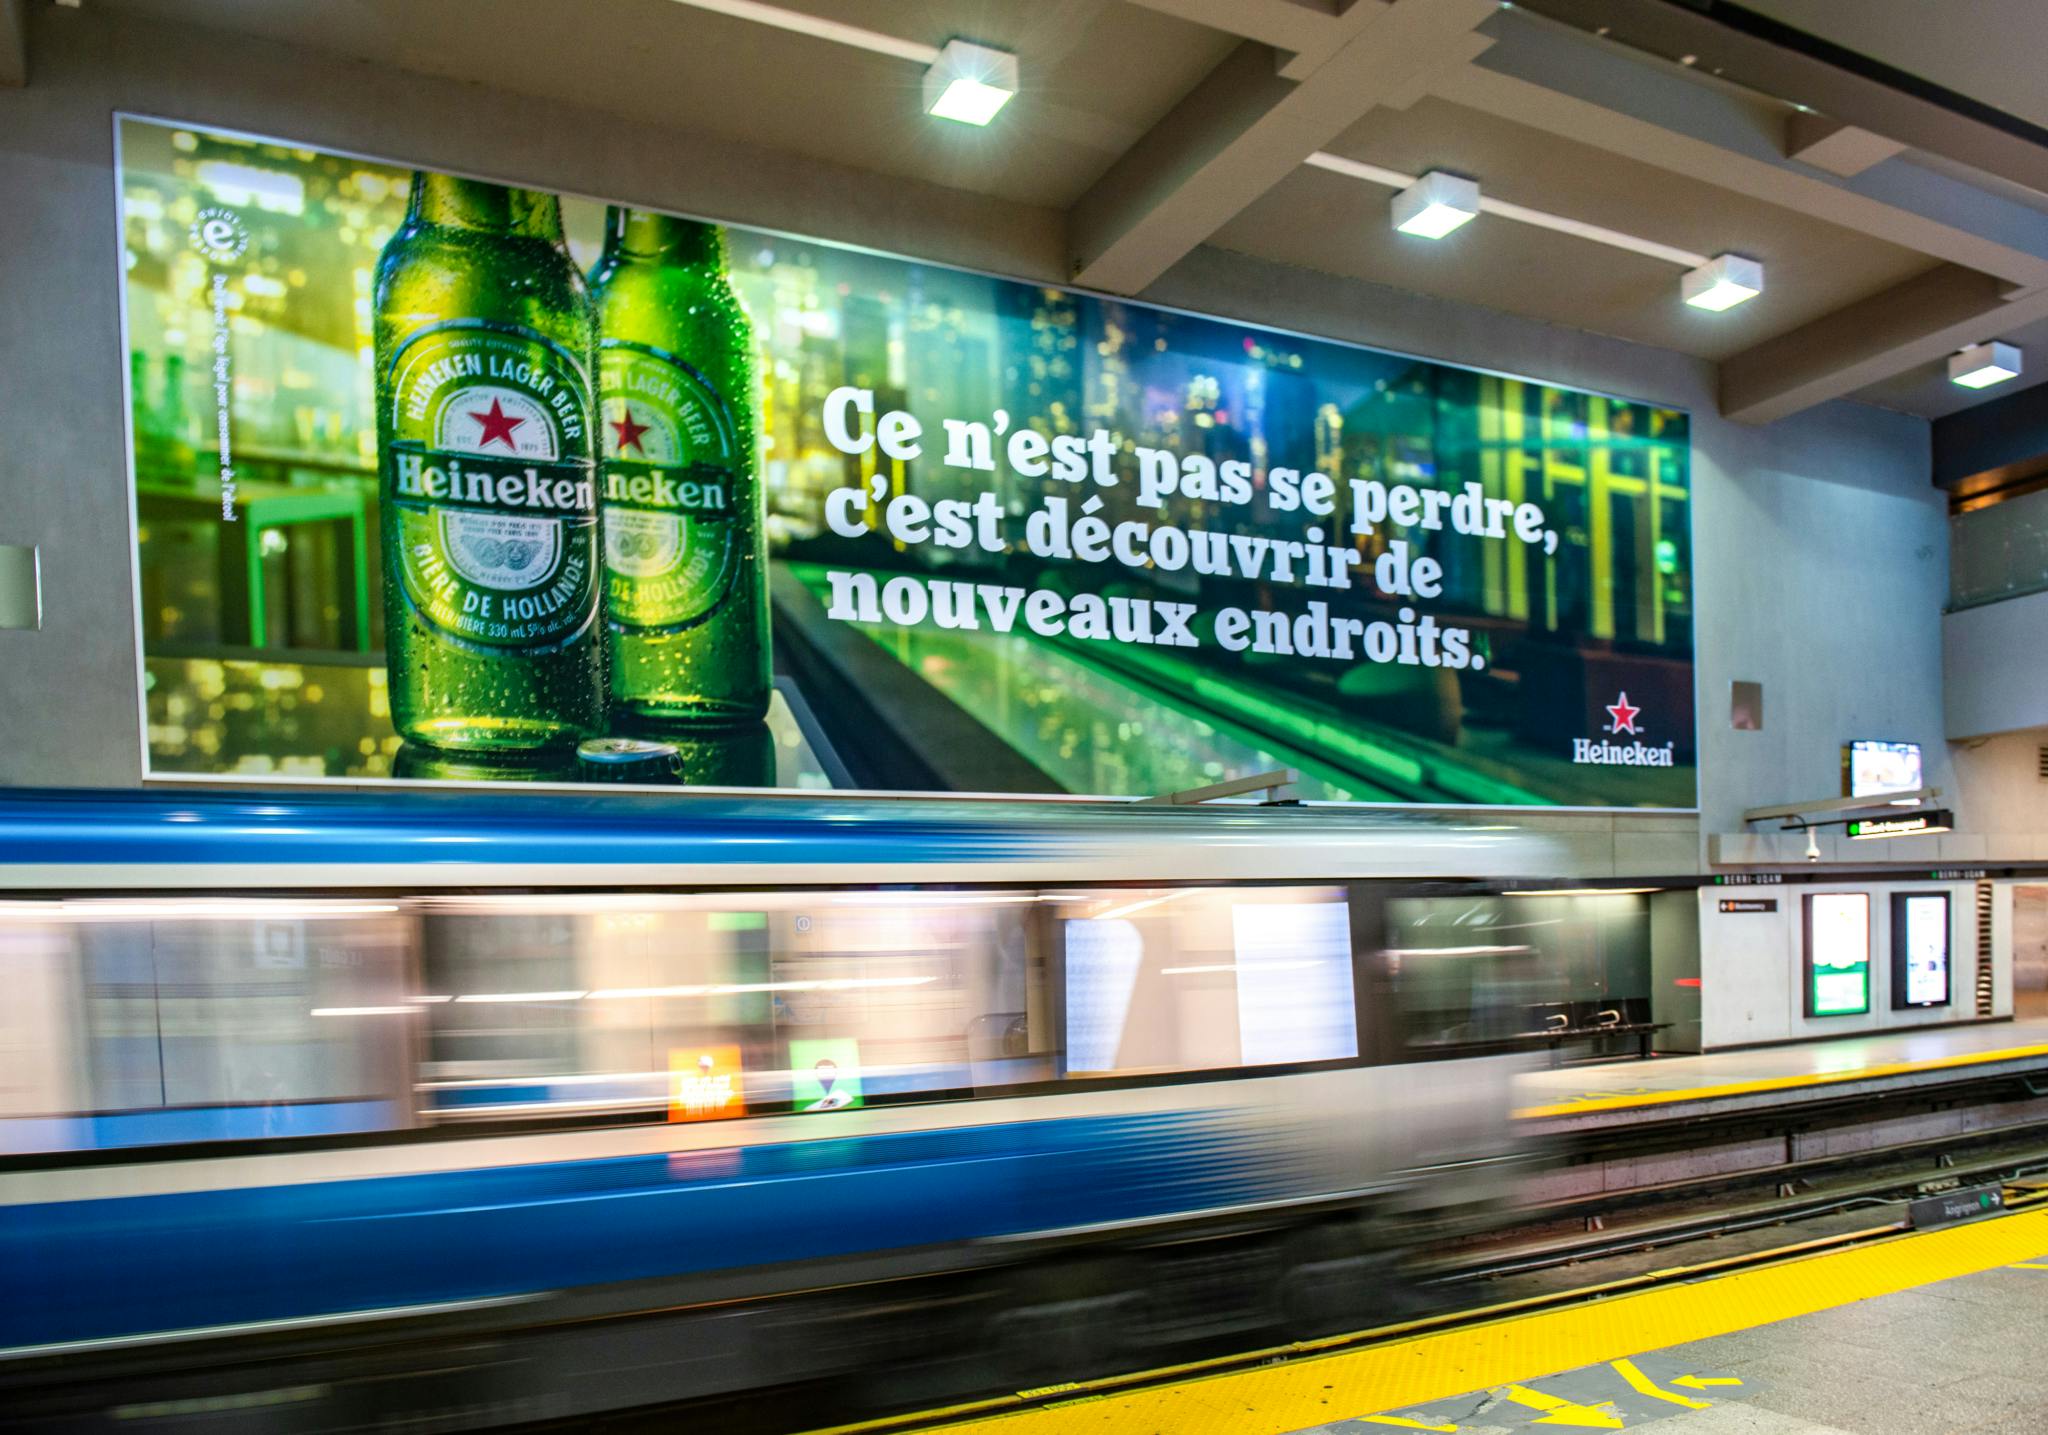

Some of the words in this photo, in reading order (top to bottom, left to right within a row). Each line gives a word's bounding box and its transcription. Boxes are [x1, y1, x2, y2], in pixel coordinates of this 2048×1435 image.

[406, 353, 484, 421] HEINEKEN
[489, 354, 556, 398] LAGER
[551, 389, 581, 441] BEER
[627, 370, 681, 406] LAGER
[679, 400, 710, 446] BEER
[221, 467, 237, 482] de
[396, 453, 596, 510] Heineken
[602, 470, 726, 510] neken
[823, 386, 923, 461] Ce
[943, 409, 1120, 487] n’est
[1135, 446, 1253, 509] pas
[1268, 464, 1336, 516] se
[1349, 477, 1559, 555] perdre,
[824, 474, 1007, 552] c’est
[1025, 494, 1361, 589] découvrir
[1375, 540, 1443, 599] de
[462, 591, 492, 618] DE
[503, 553, 585, 620] HOLLANDE
[488, 622, 508, 639] 330
[826, 570, 1199, 647] nouveaux
[1214, 600, 1486, 671] endroits.
[1573, 738, 1674, 766] Heineken
[1724, 874, 1782, 885] BERRI-UQAM
